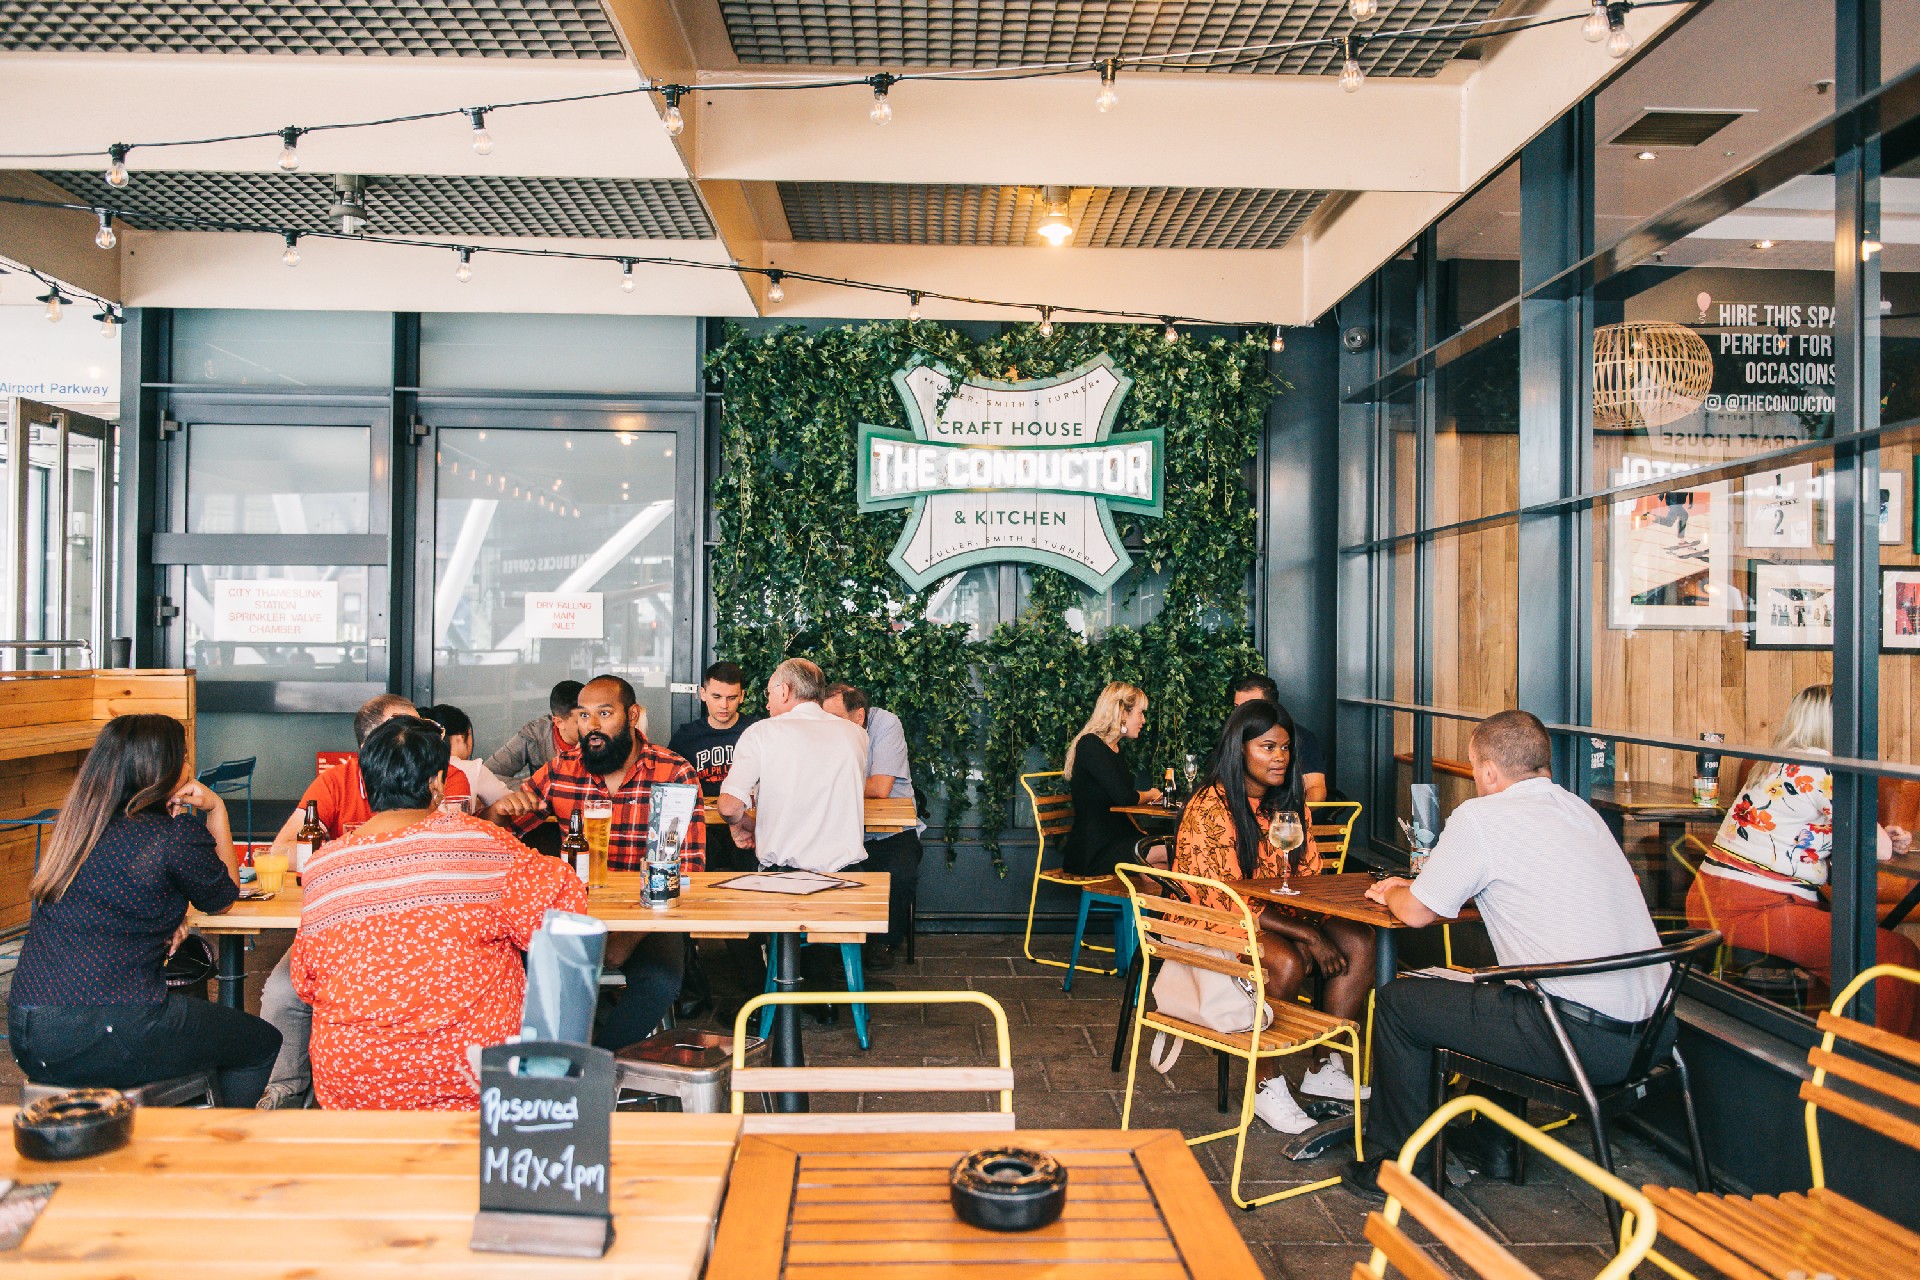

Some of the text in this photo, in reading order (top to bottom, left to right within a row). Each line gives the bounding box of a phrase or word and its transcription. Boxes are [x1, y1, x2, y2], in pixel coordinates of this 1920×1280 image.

[1719, 304, 1835, 329] HIRE THIS SPA
[1720, 333, 1832, 357] PERFECT FOR
[1745, 362, 1835, 385] OCCASIONS
[0, 382, 109, 397] Airport Parkway
[986, 399, 1025, 408] SMITH
[1047, 382, 1095, 404] TURNER
[936, 420, 1083, 437] CRAFT HOUSE
[874, 444, 1148, 494] THE CONDUCTOR
[954, 511, 1067, 526] & KITCHEN
[986, 536, 1023, 544] SMITH
[228, 588, 323, 598] CITY THAMESLINK
[254, 600, 297, 610] STATION
[536, 601, 553, 609] DRY
[228, 612, 323, 623] SPRINKLER VALVE
[249, 624, 301, 634] CHAMBER
[552, 622, 575, 630] INLET
[696, 745, 734, 772] POL
[482, 1087, 579, 1136] Reserved
